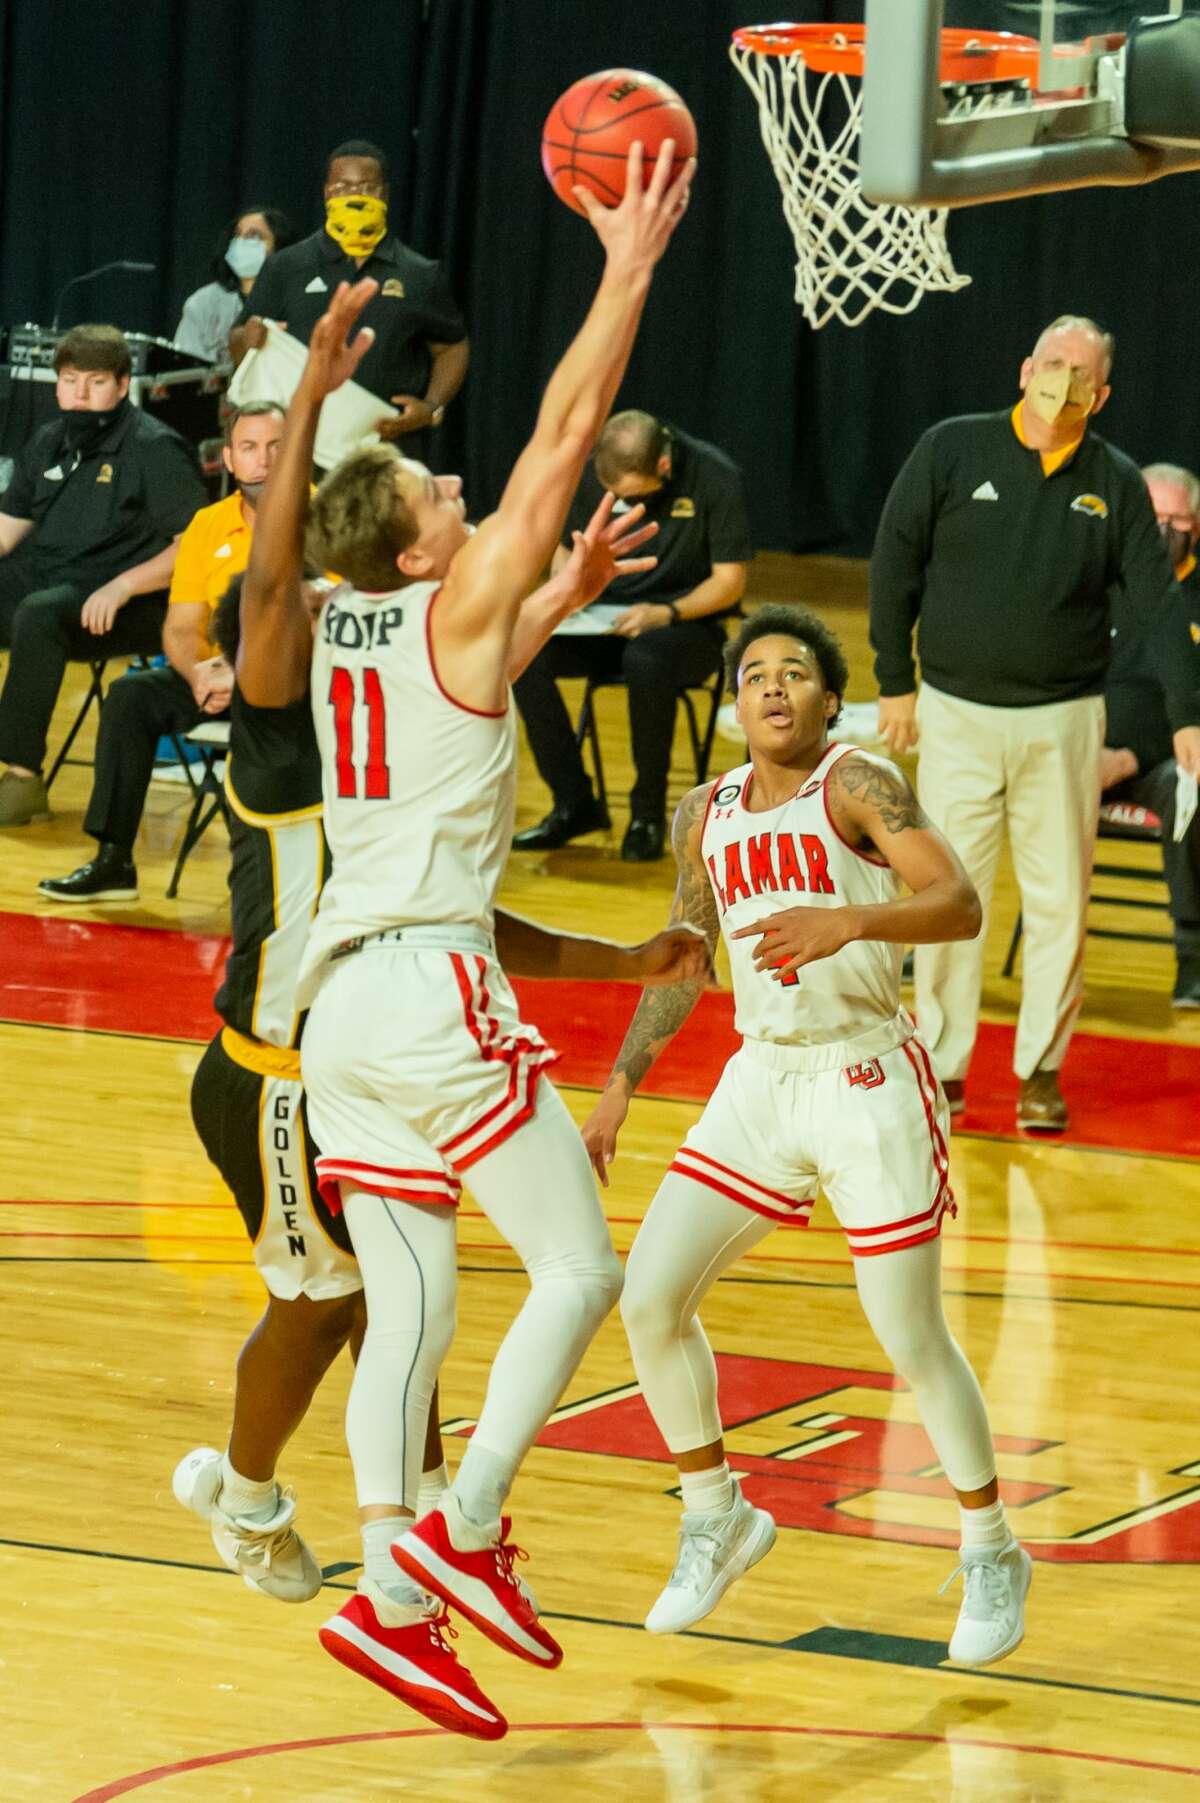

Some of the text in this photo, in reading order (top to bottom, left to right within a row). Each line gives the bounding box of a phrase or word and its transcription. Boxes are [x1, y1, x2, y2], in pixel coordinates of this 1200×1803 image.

[328, 666, 390, 799] 11
[707, 832, 836, 916] LAMAR
[274, 1096, 307, 1257] GOLDEN
